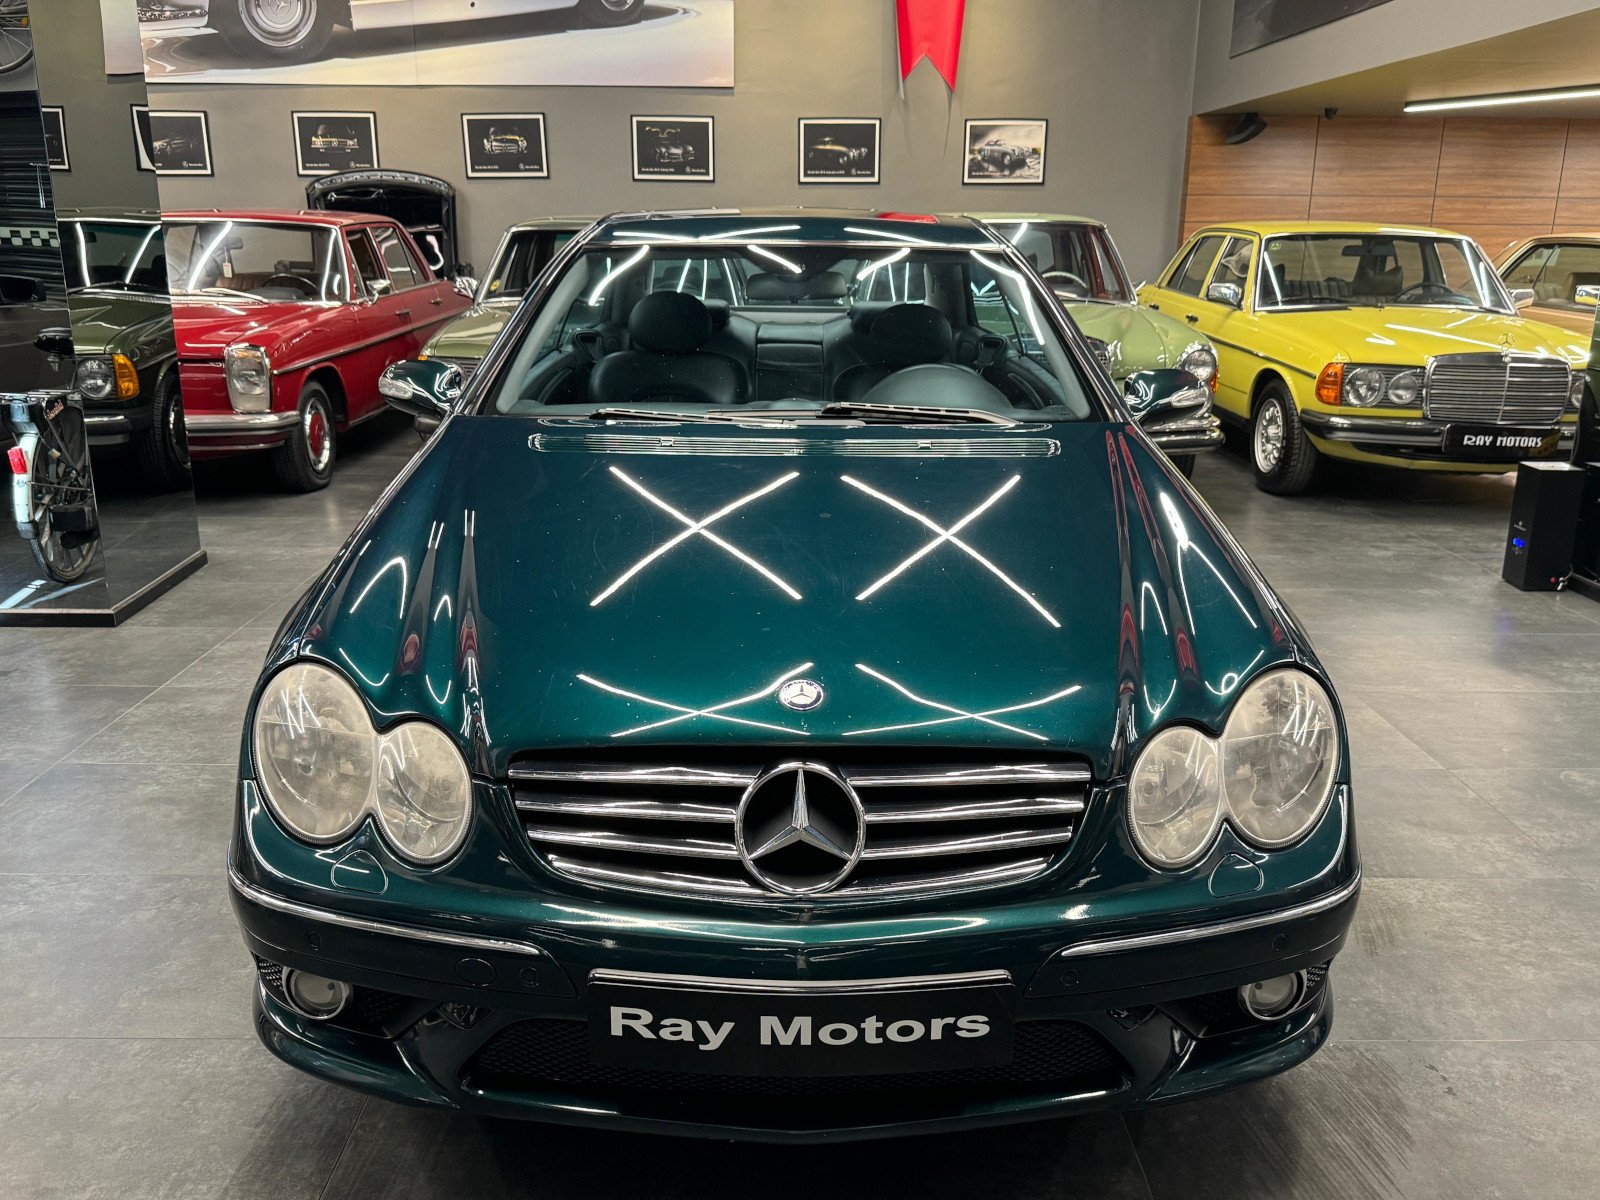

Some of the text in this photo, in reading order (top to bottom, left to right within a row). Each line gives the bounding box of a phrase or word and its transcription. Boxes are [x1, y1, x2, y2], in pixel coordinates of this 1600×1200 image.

[1463, 434, 1543, 448] RAY MOTORS
[610, 1006, 991, 1051] Ray Motors
